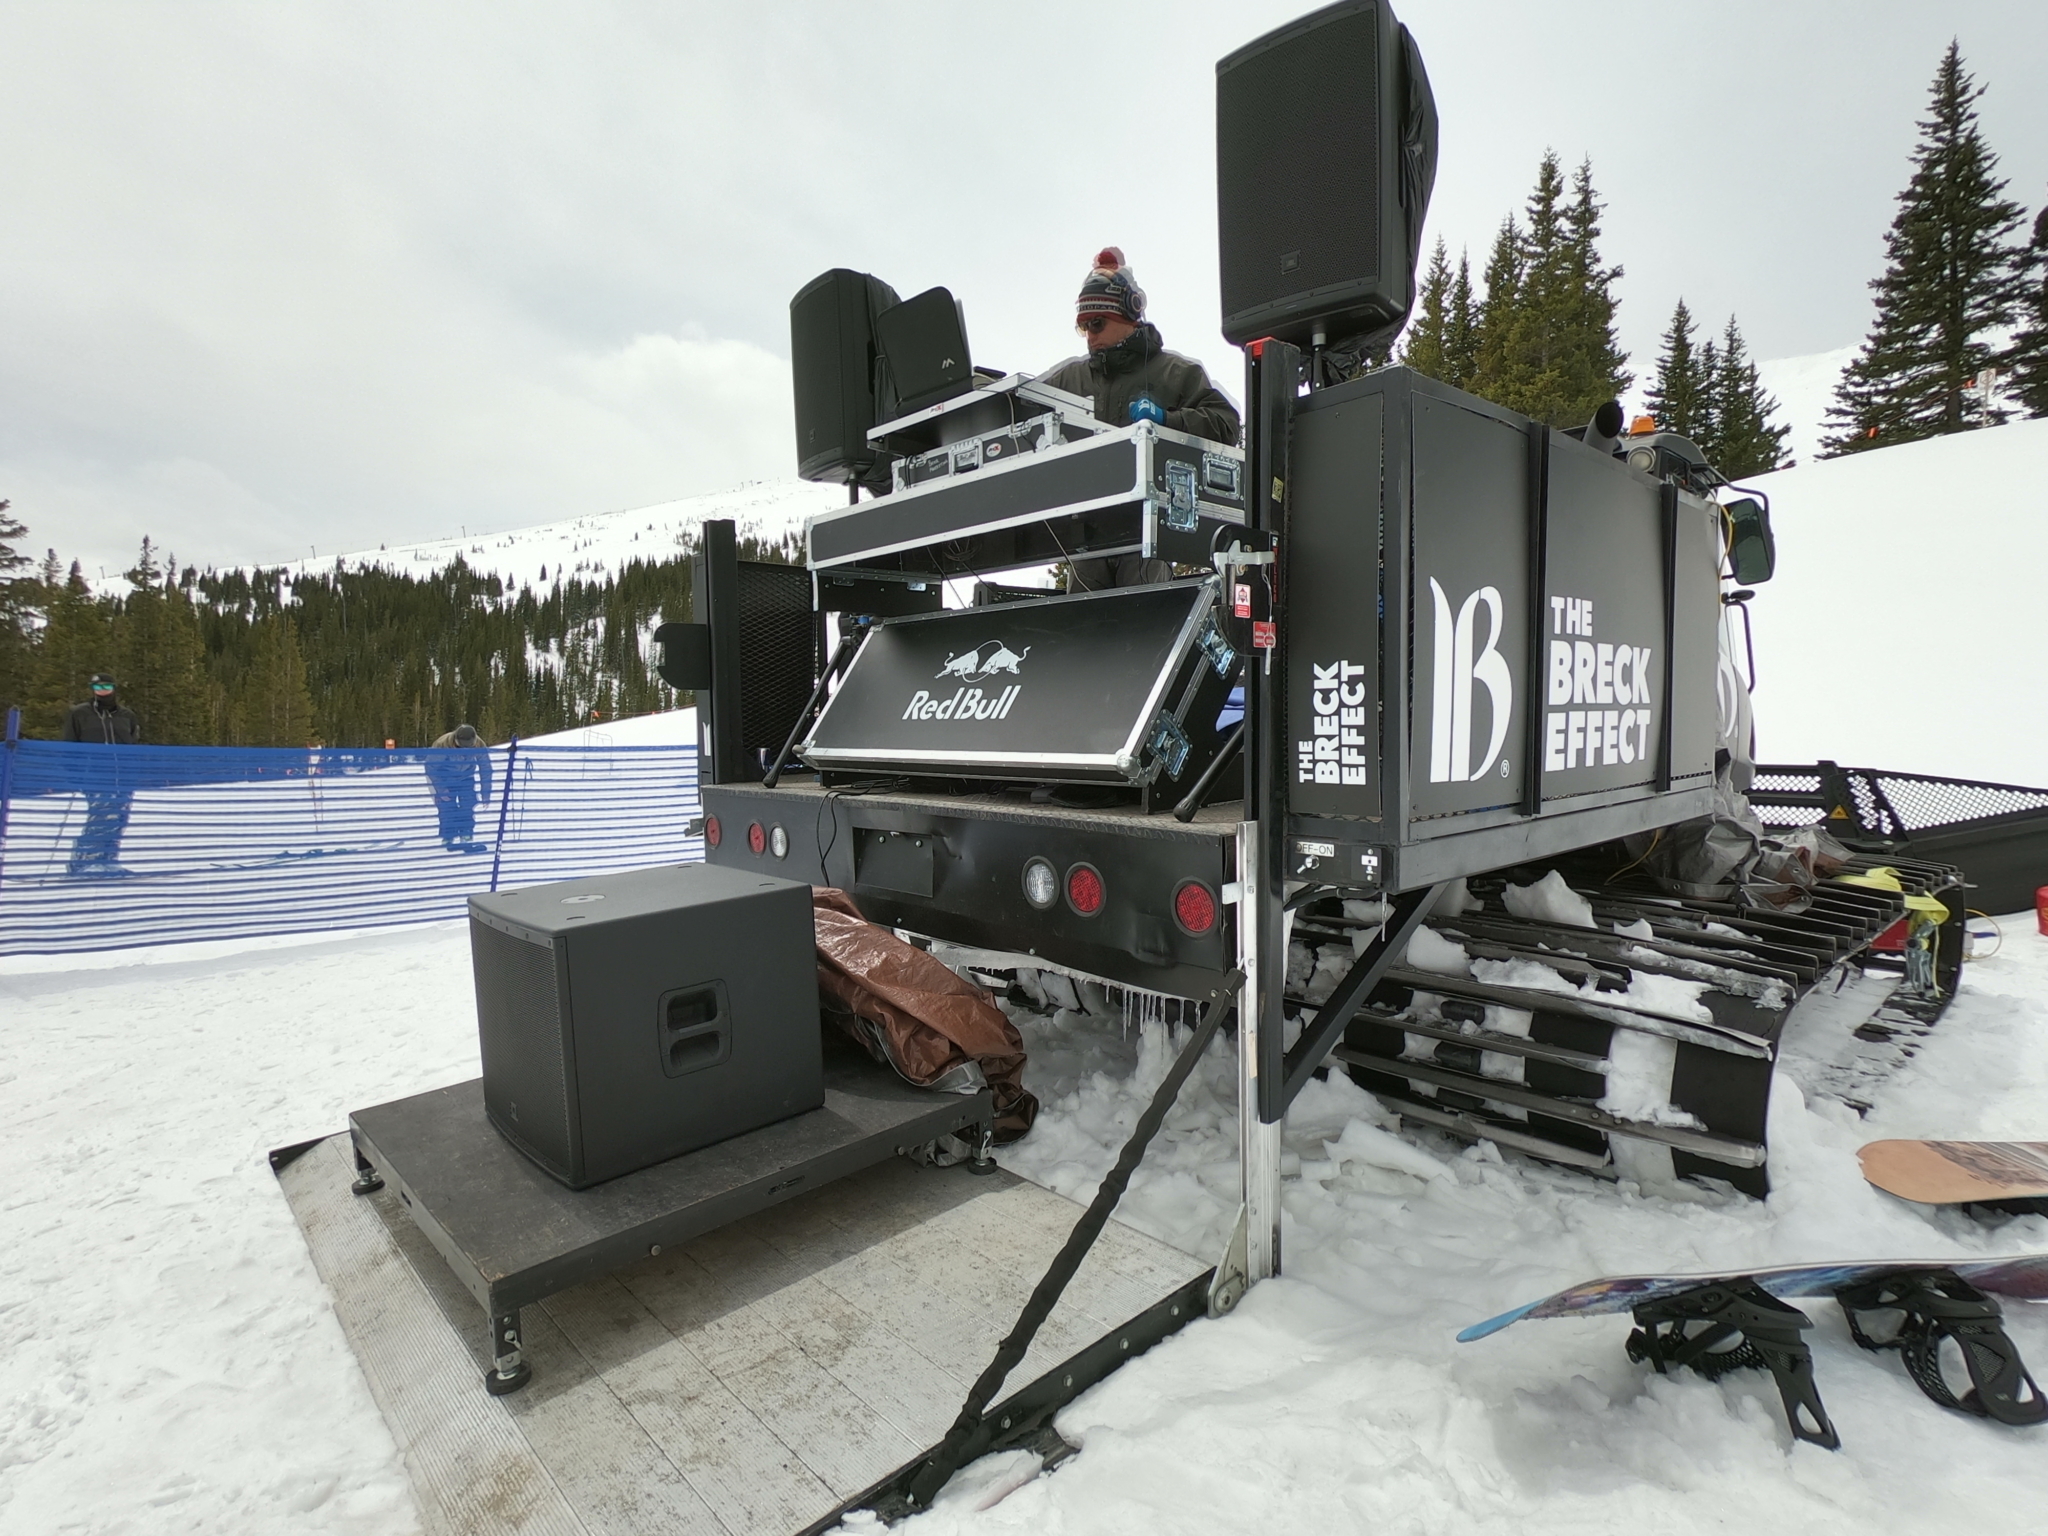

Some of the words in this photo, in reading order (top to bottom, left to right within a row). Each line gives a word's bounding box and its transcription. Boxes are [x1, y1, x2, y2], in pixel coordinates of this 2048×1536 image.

[1550, 596, 1593, 636] THE
[1548, 640, 1652, 705] BRECK
[1313, 660, 1340, 784] BRECK
[1340, 659, 1366, 786] EFFECT
[1545, 708, 1652, 772] EFFECT
[1298, 740, 1314, 783] THE
[1296, 843, 1333, 855] OFF-ON
